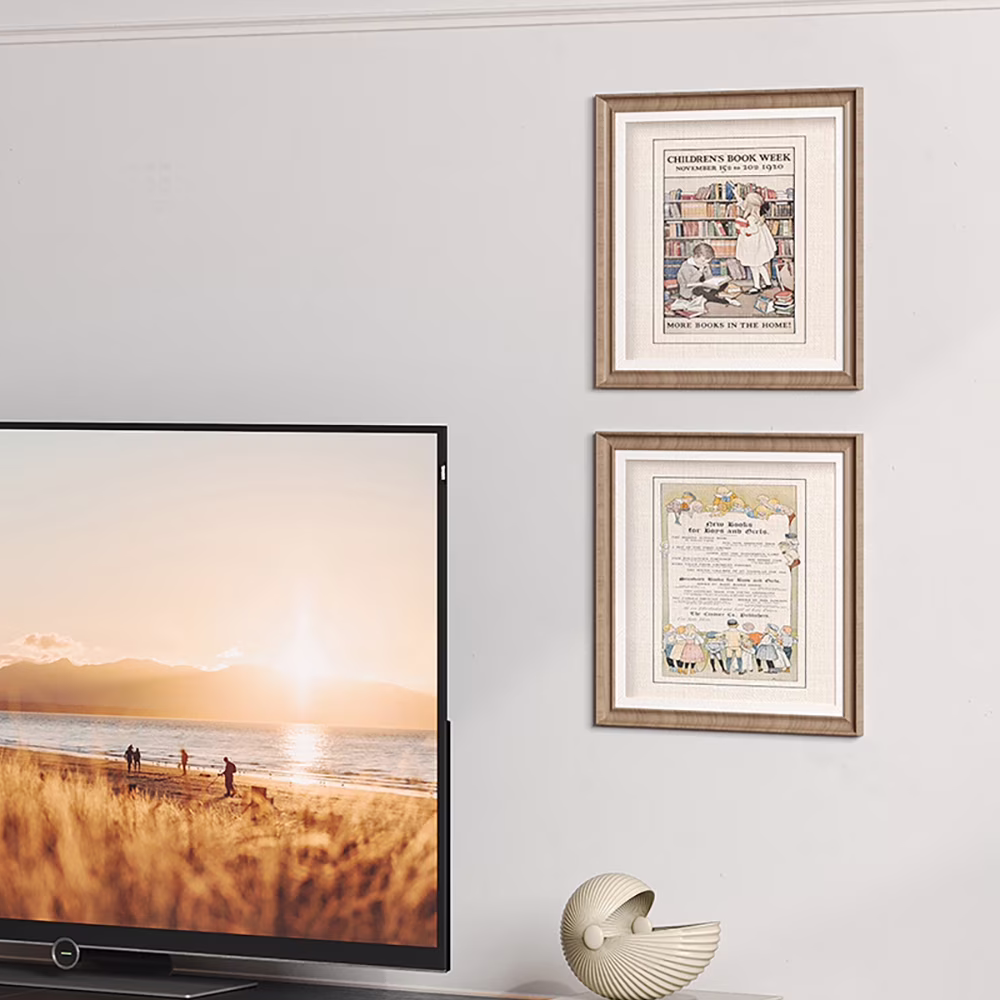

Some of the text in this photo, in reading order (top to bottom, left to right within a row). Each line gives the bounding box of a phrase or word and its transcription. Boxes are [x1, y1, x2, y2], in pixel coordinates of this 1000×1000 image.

[667, 153, 791, 164] CHILDREN'S BOOK WEEK
